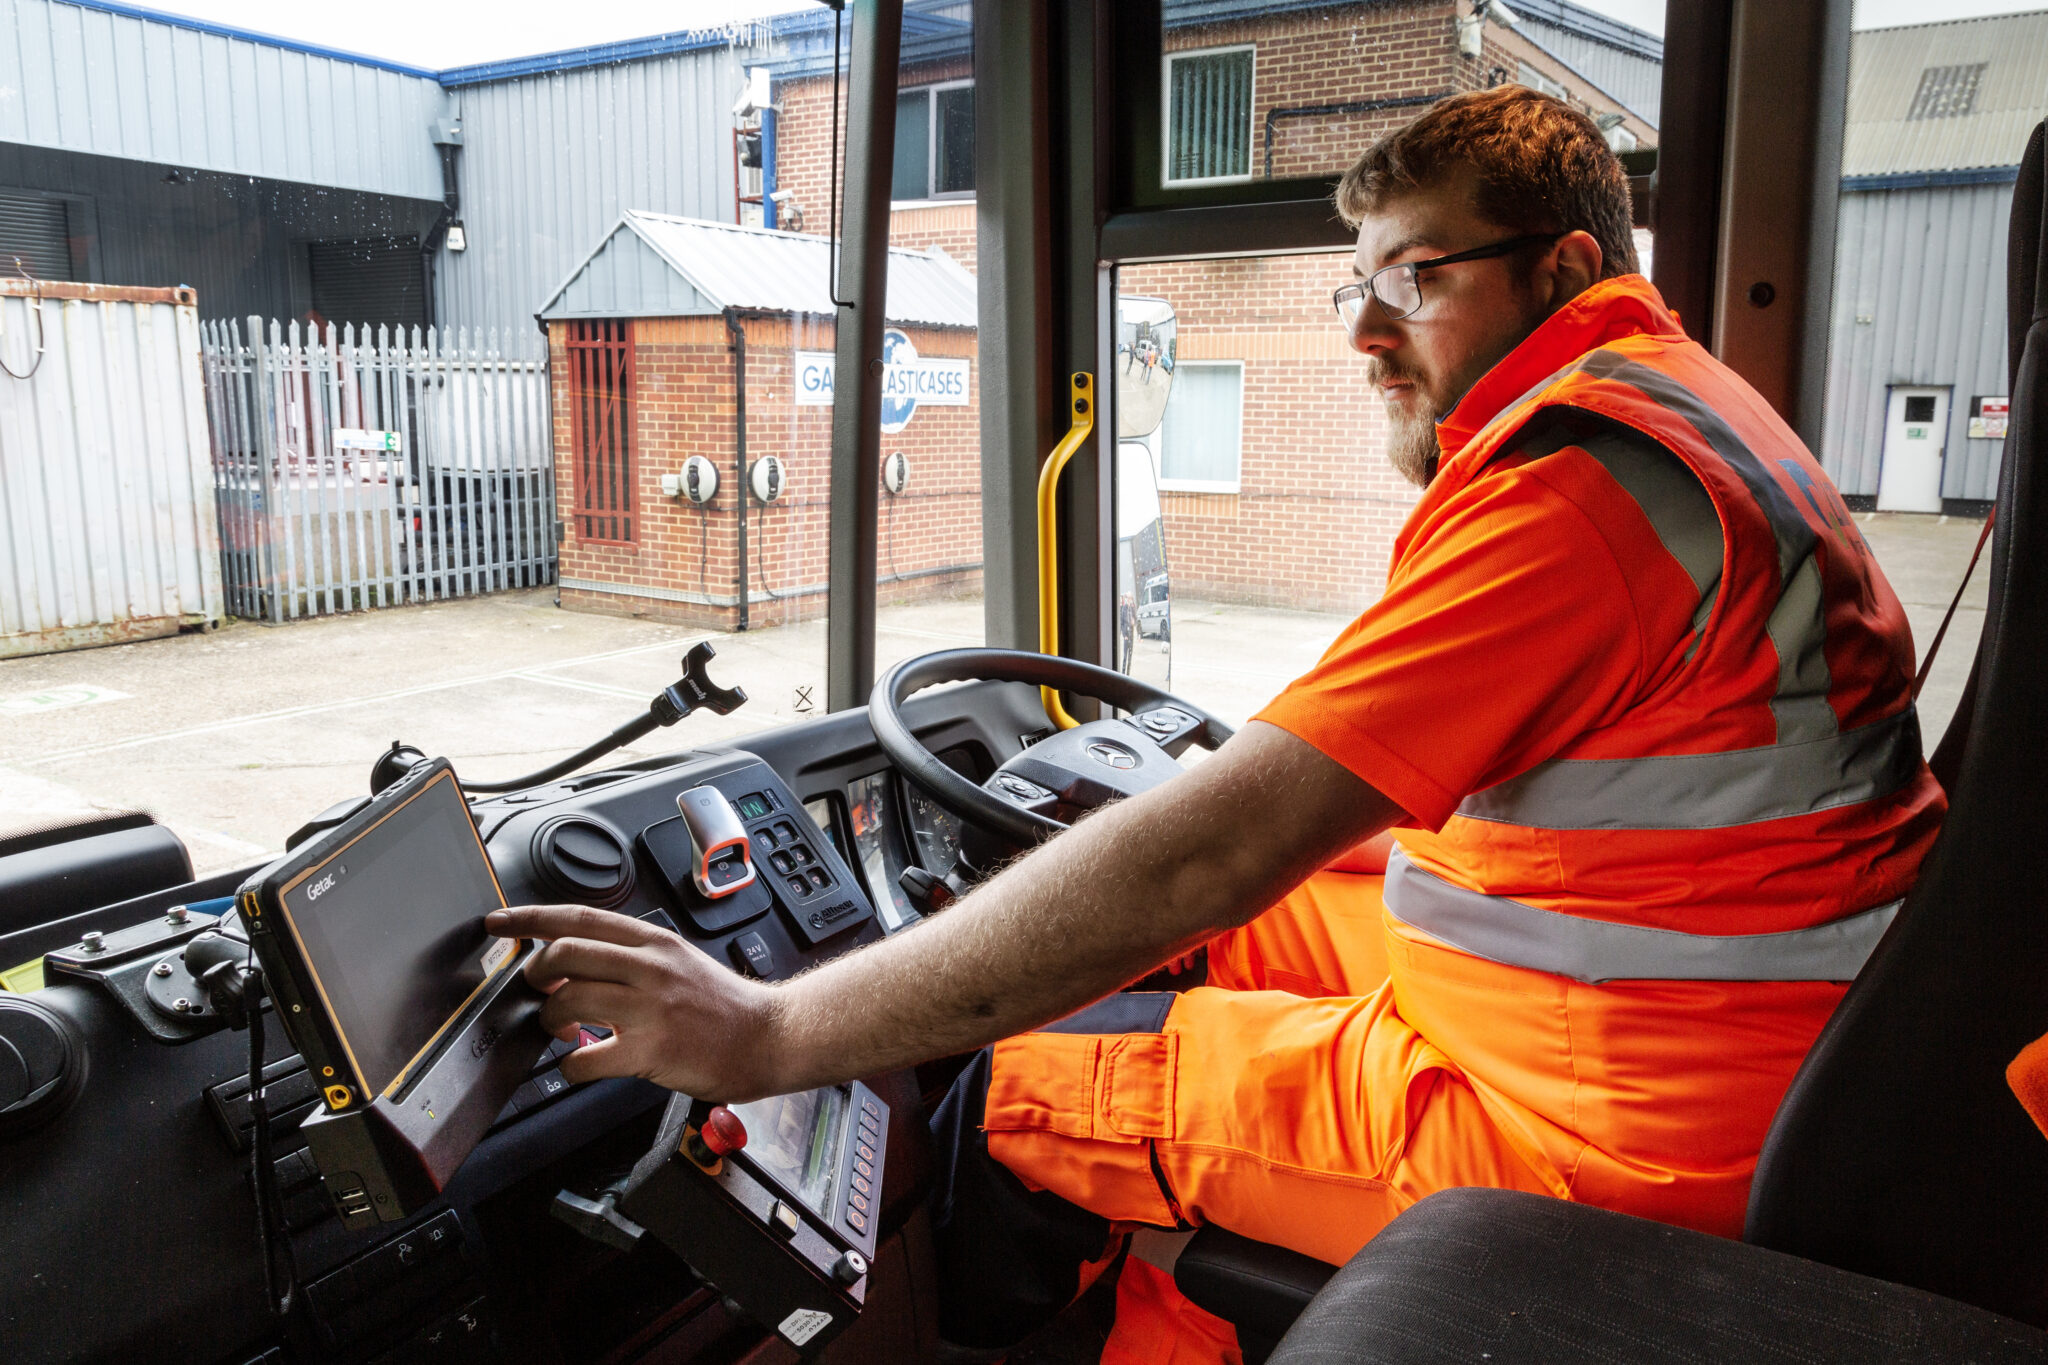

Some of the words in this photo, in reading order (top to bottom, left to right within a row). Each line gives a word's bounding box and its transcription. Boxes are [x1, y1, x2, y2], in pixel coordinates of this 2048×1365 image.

[803, 365, 834, 393] GA
[882, 370, 963, 395] ASTICASES
[759, 837, 769, 846] R
[307, 872, 336, 901] Getac
[792, 883, 802, 893] D
[746, 943, 762, 956] 24V
